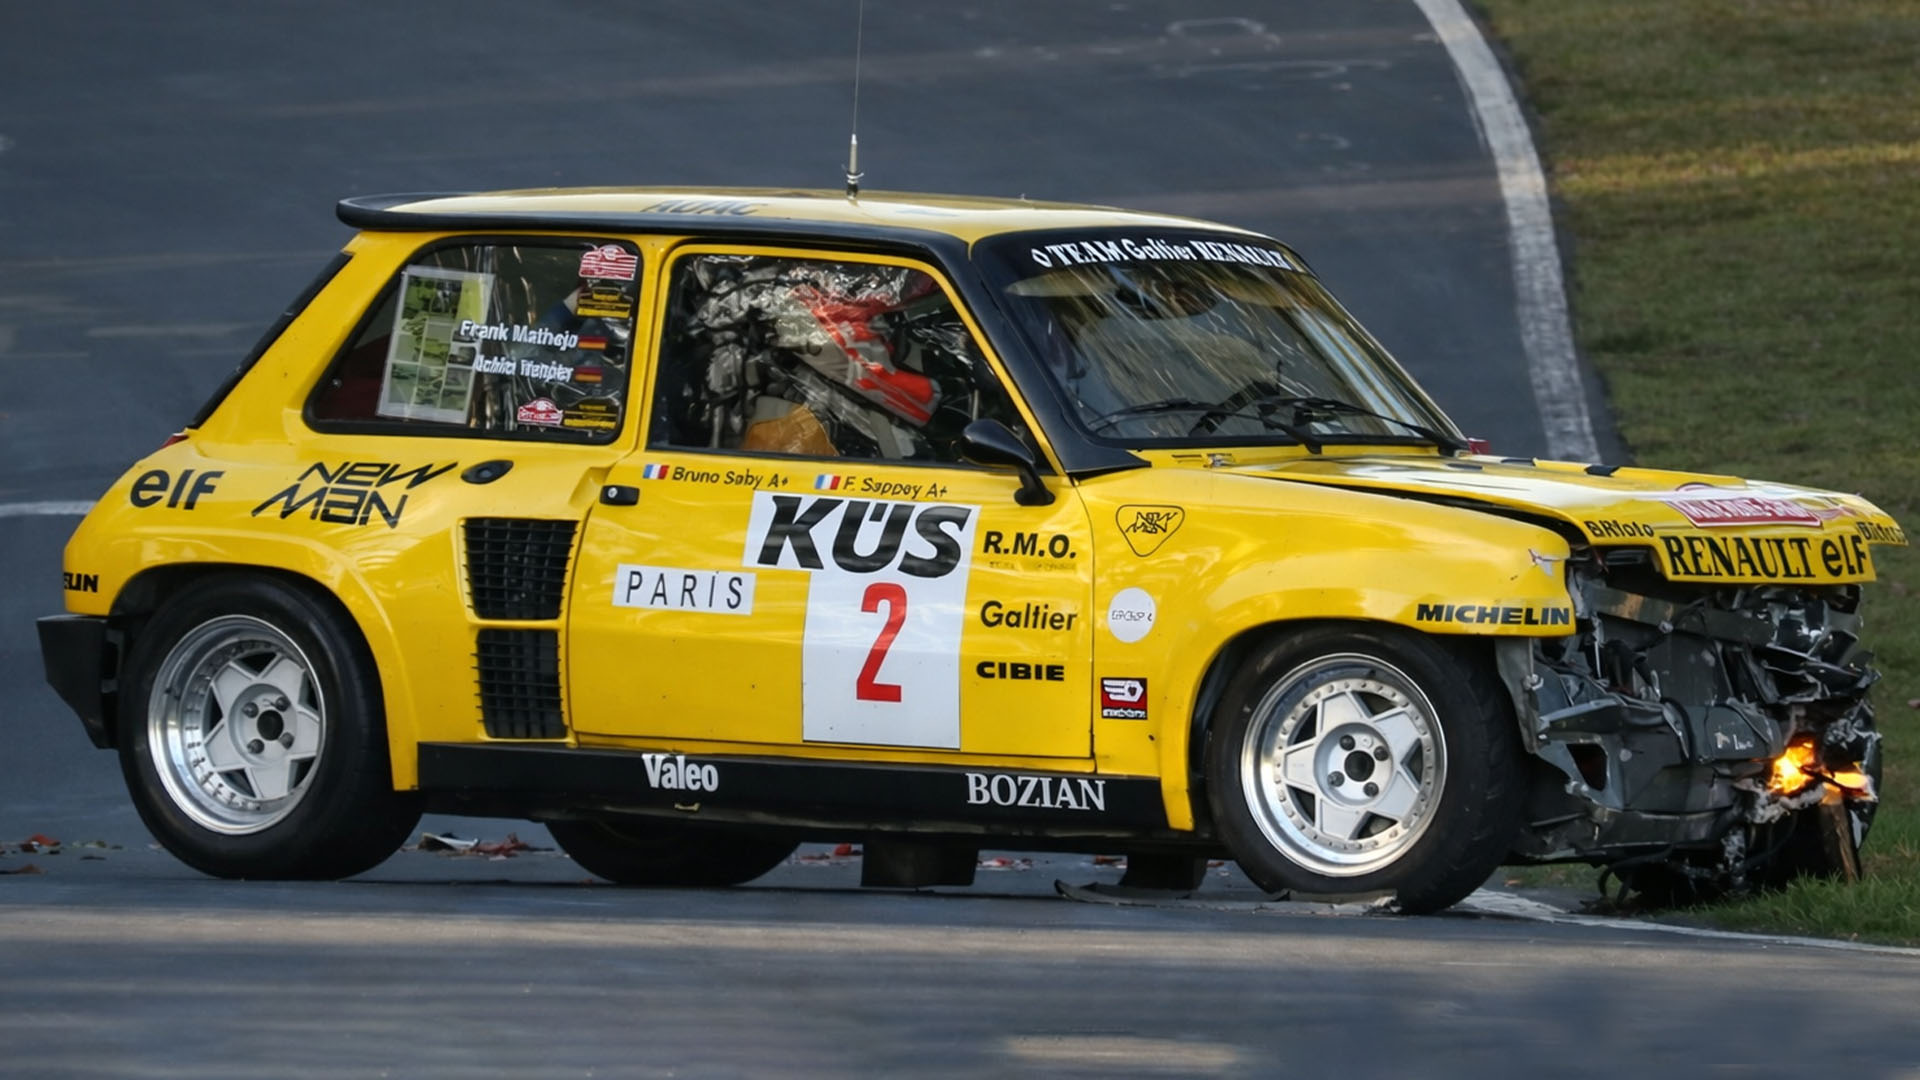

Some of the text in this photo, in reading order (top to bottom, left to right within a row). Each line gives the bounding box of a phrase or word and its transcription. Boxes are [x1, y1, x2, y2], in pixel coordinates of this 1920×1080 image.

[1044, 240, 1131, 266] TEAM
[460, 320, 508, 341] Frank
[130, 469, 226, 510] elf
[672, 466, 719, 484] Bruno
[757, 496, 971, 579] KÜS
[983, 531, 1077, 559] R.M.O.
[1660, 535, 1816, 578] RENAULT
[981, 600, 1077, 631] Galtier
[1416, 604, 1569, 625] MICHELIN
[856, 582, 908, 703] 2
[976, 661, 1064, 681] CIBIE
[642, 754, 718, 792] Valeo
[965, 773, 1105, 811] BOZIAN
